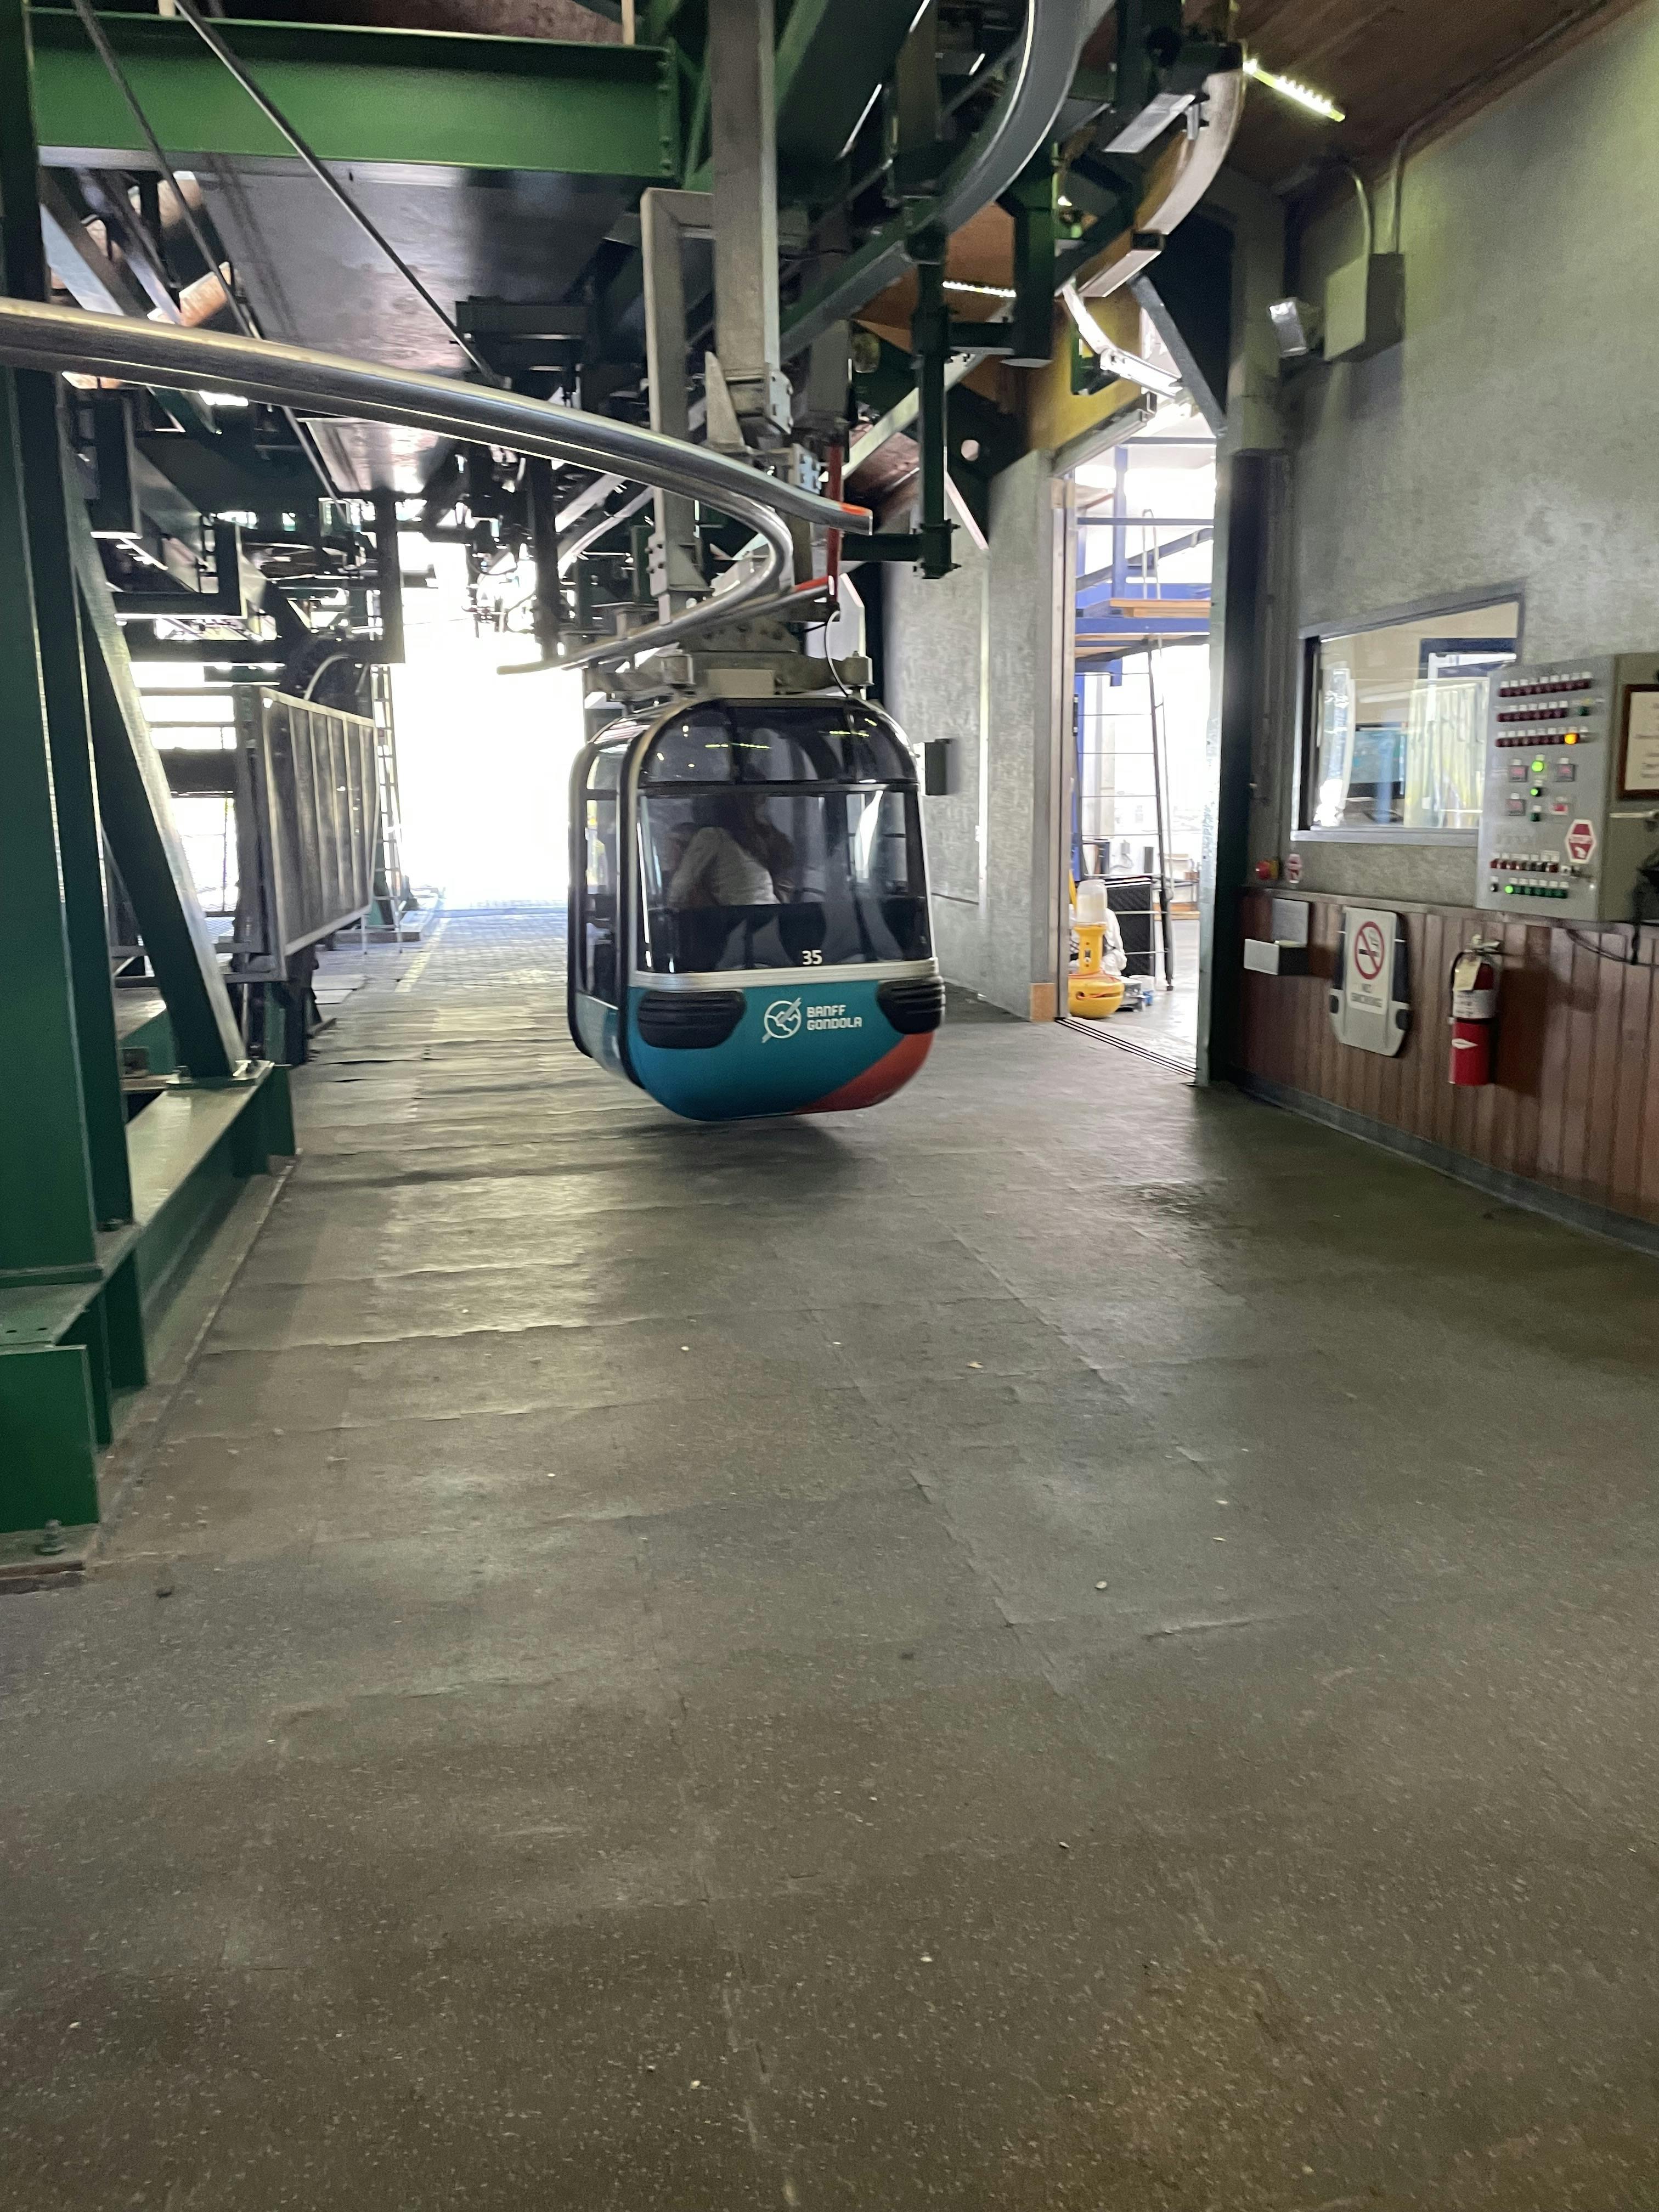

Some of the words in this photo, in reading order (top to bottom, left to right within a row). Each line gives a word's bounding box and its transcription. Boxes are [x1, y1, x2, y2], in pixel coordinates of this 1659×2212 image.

[802, 950, 822, 964] 35
[807, 1005, 847, 1018] BANFF
[807, 1017, 862, 1030] GONDOLA
